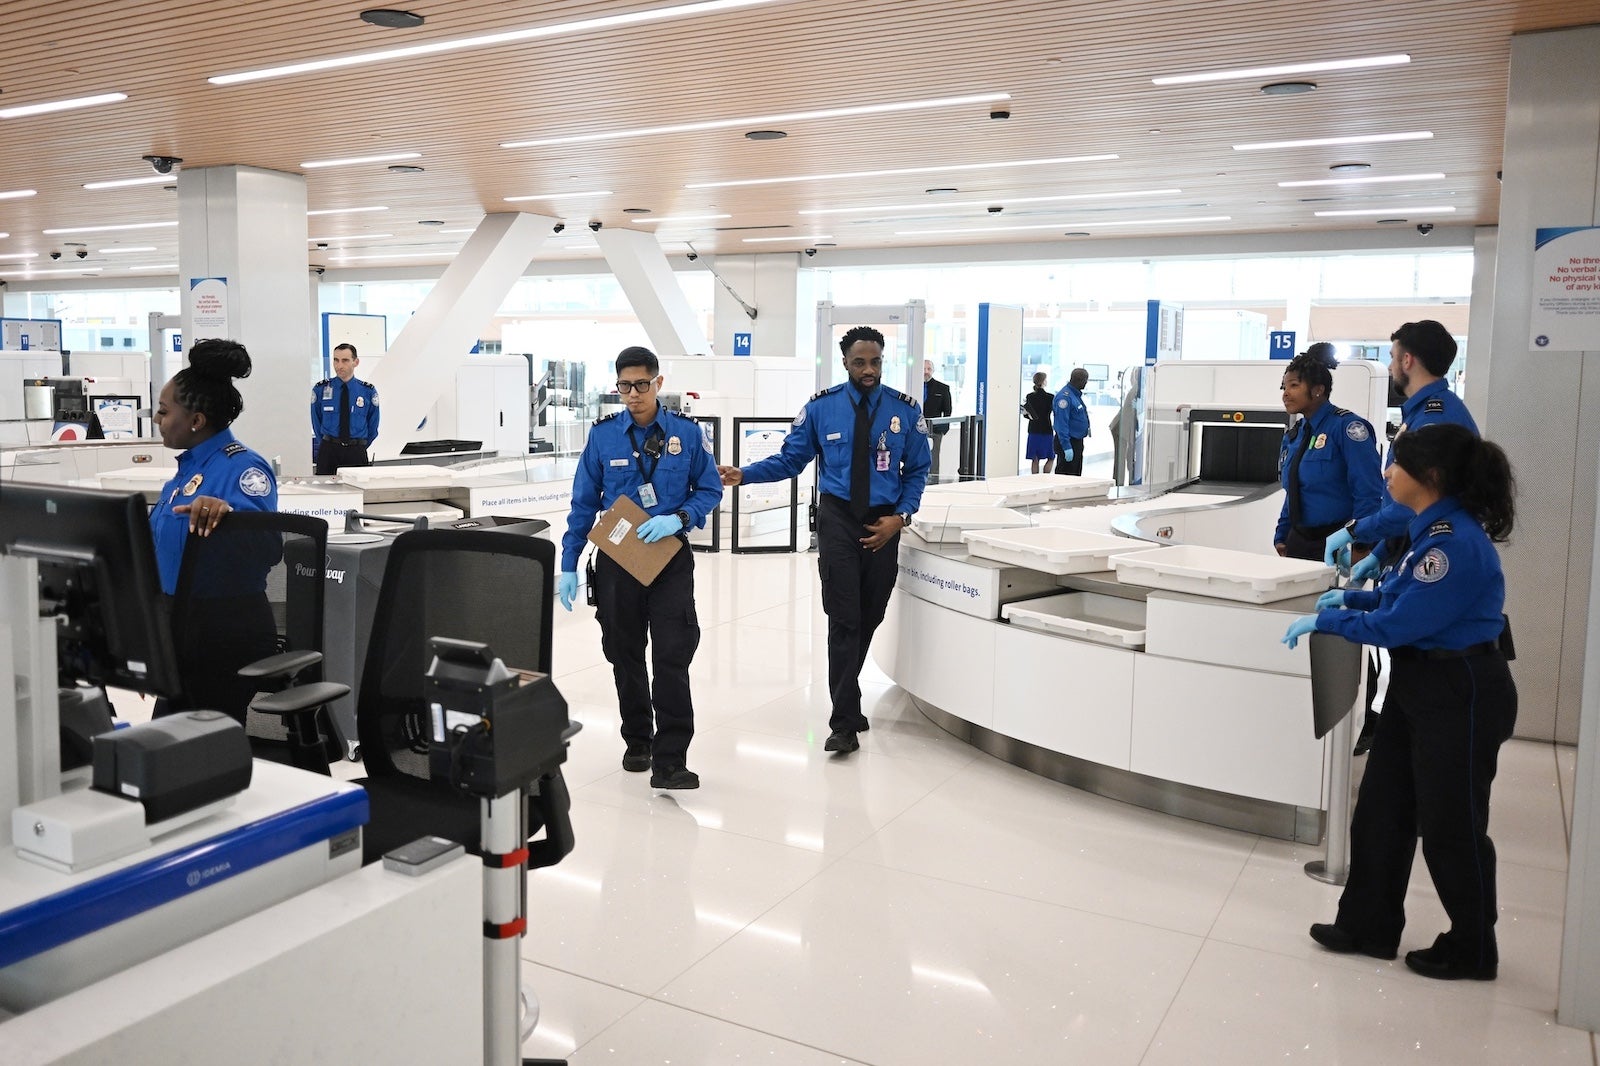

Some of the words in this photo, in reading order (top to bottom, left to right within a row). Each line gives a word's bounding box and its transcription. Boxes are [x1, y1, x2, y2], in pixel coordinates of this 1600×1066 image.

[1562, 274, 1596, 283] physical
[22, 336, 28, 345] 11
[173, 336, 182, 346] 12
[736, 335, 749, 348] 14
[1274, 334, 1291, 349] 15
[498, 498, 506, 506] all
[506, 497, 521, 505] items
[539, 493, 559, 501] including
[311, 508, 332, 516] roller
[333, 508, 348, 516] bag
[295, 562, 317, 577] Pour
[325, 569, 346, 584] way
[920, 570, 945, 590] including
[944, 579, 962, 591] roller
[962, 583, 981, 598] bags.
[201, 861, 232, 880] IDEMIA
